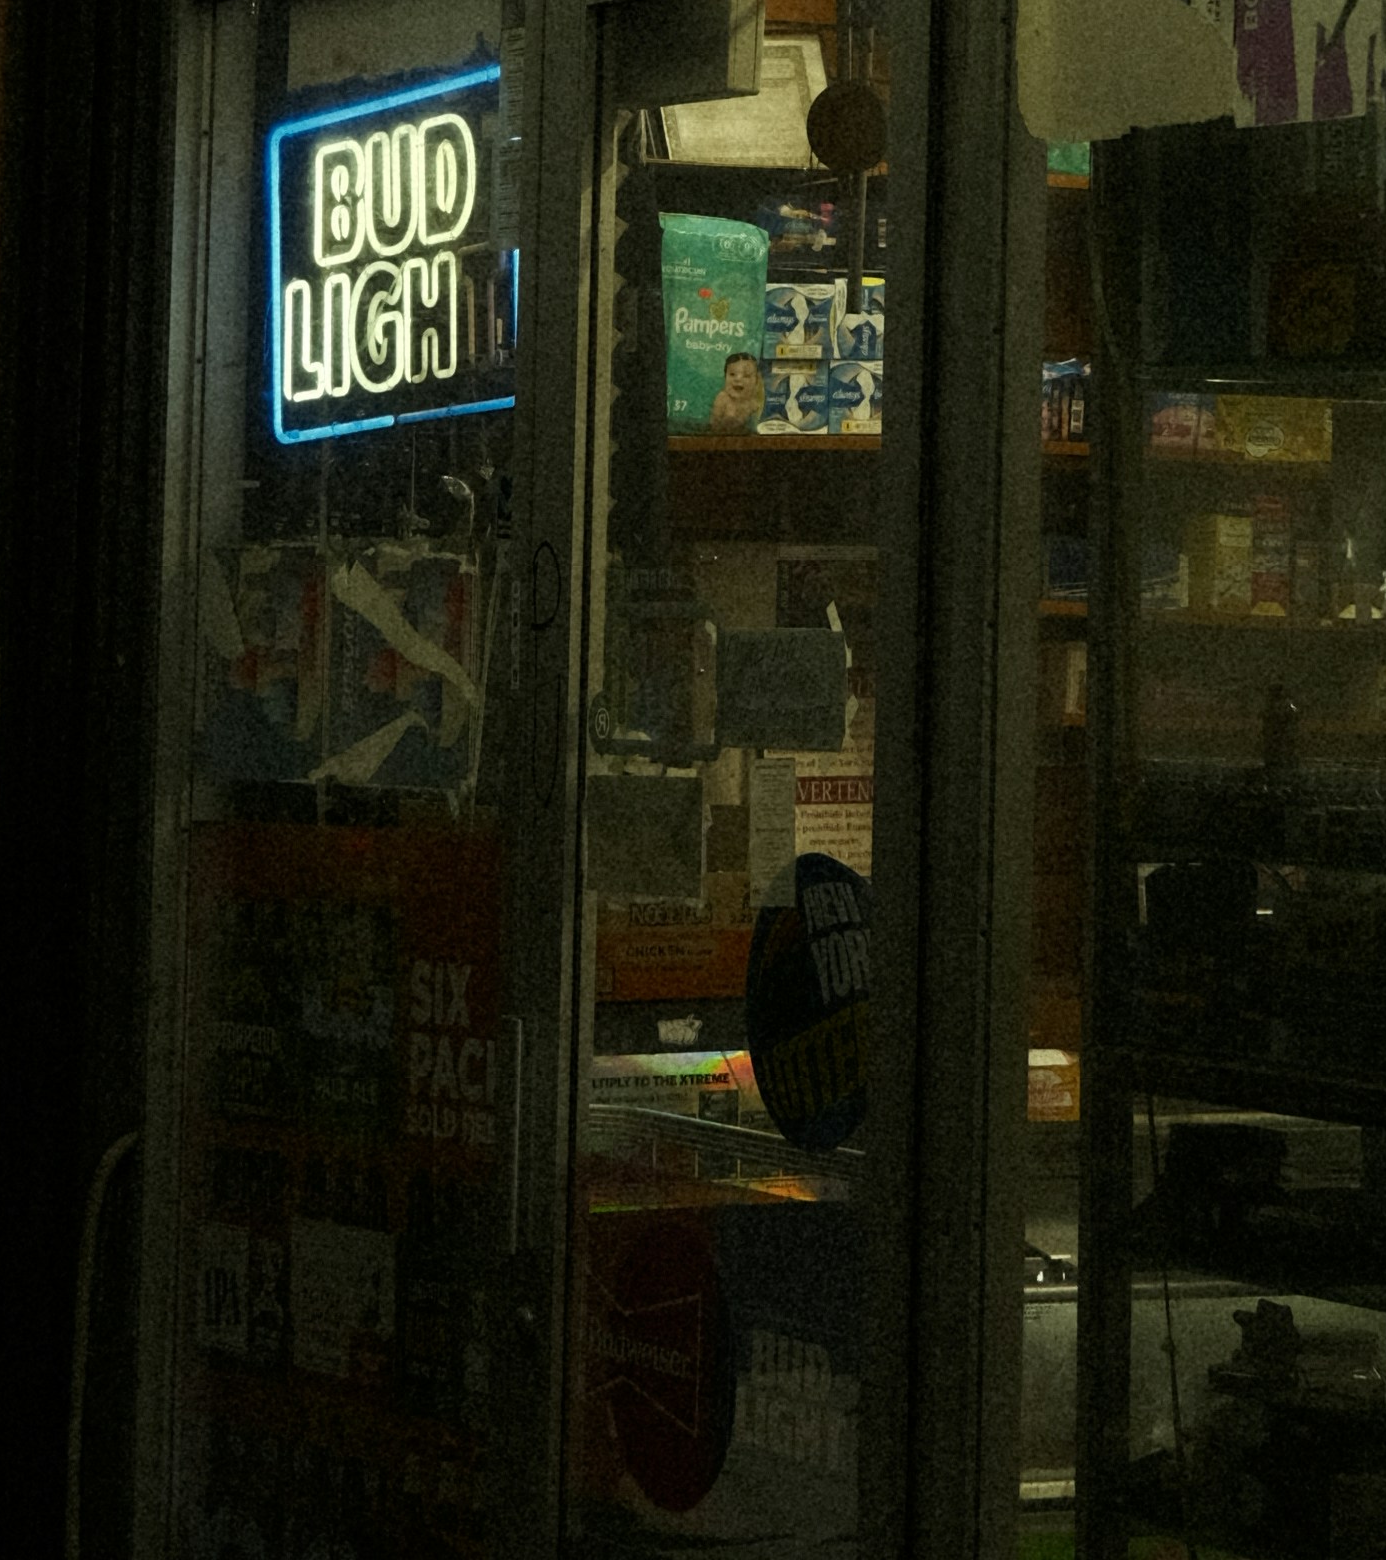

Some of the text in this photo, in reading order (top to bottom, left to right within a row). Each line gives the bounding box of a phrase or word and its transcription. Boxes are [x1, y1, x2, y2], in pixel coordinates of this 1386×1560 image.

[312, 112, 478, 269] BUD
[674, 306, 746, 339] Pampers
[685, 339, 734, 354] baby-dry
[802, 880, 863, 934] NEW
[409, 958, 473, 1028] SIX
[810, 927, 871, 1006] YOR
[653, 1074, 678, 1087] THE
[680, 1072, 730, 1086] XTREME
[749, 1327, 833, 1402] BUD
[733, 1383, 849, 1473] LIGHT
